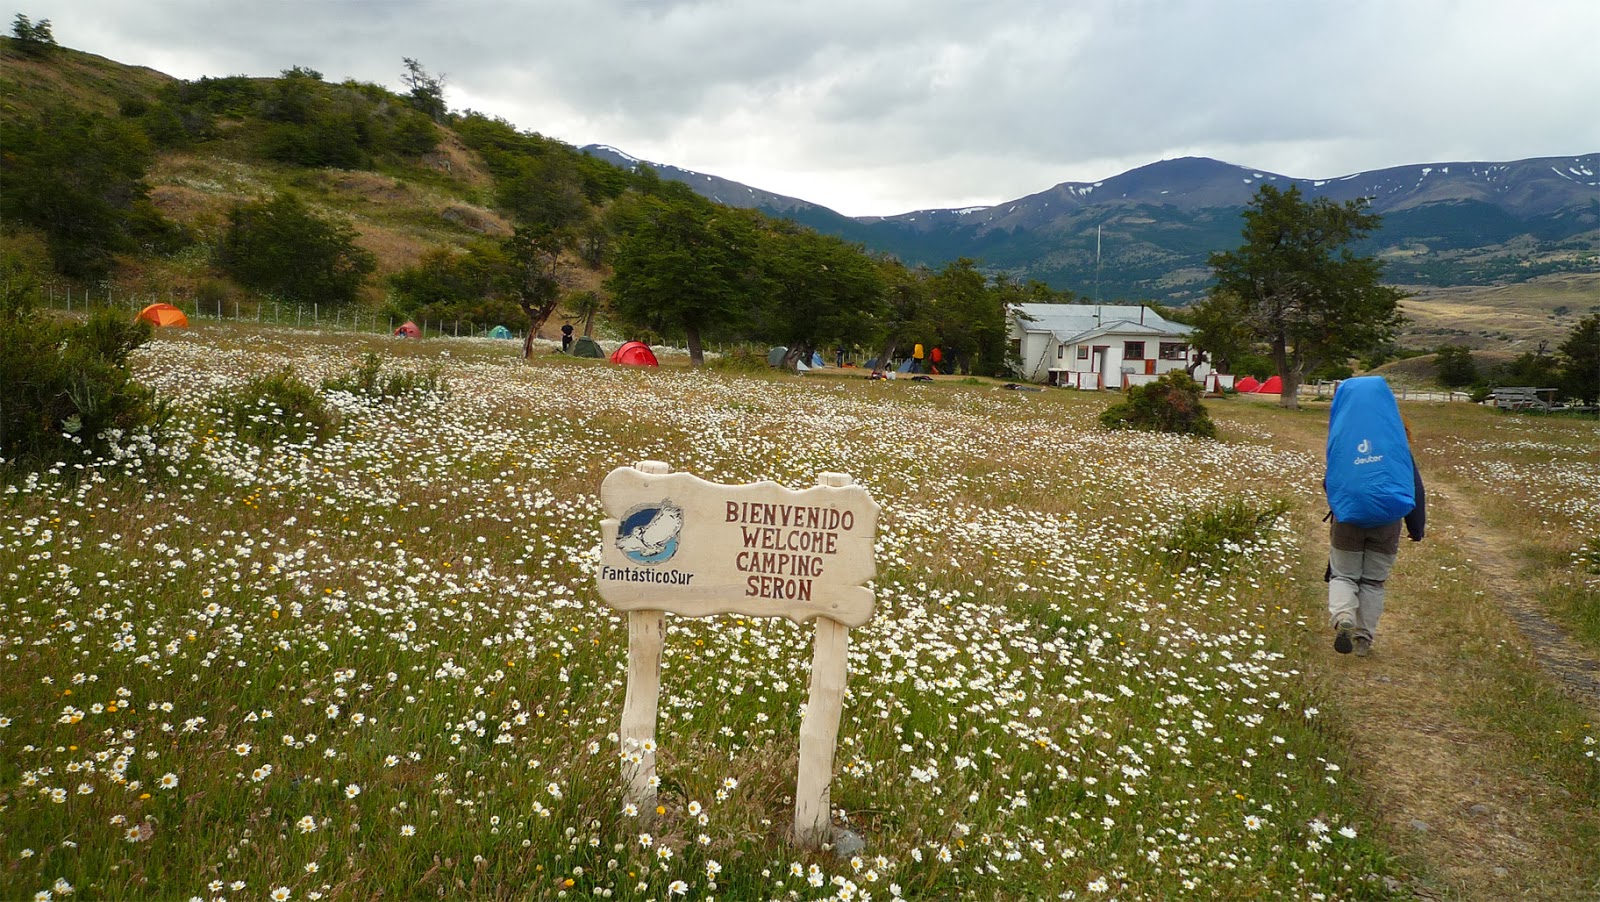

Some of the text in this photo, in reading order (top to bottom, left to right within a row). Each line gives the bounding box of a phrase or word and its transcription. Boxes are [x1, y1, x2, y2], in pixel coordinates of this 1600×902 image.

[1354, 454, 1383, 465] deuter
[725, 501, 854, 531] BIENVENIDO
[740, 526, 838, 554] WELCOME
[736, 552, 824, 577] CAMPING
[745, 576, 812, 601] SERON
